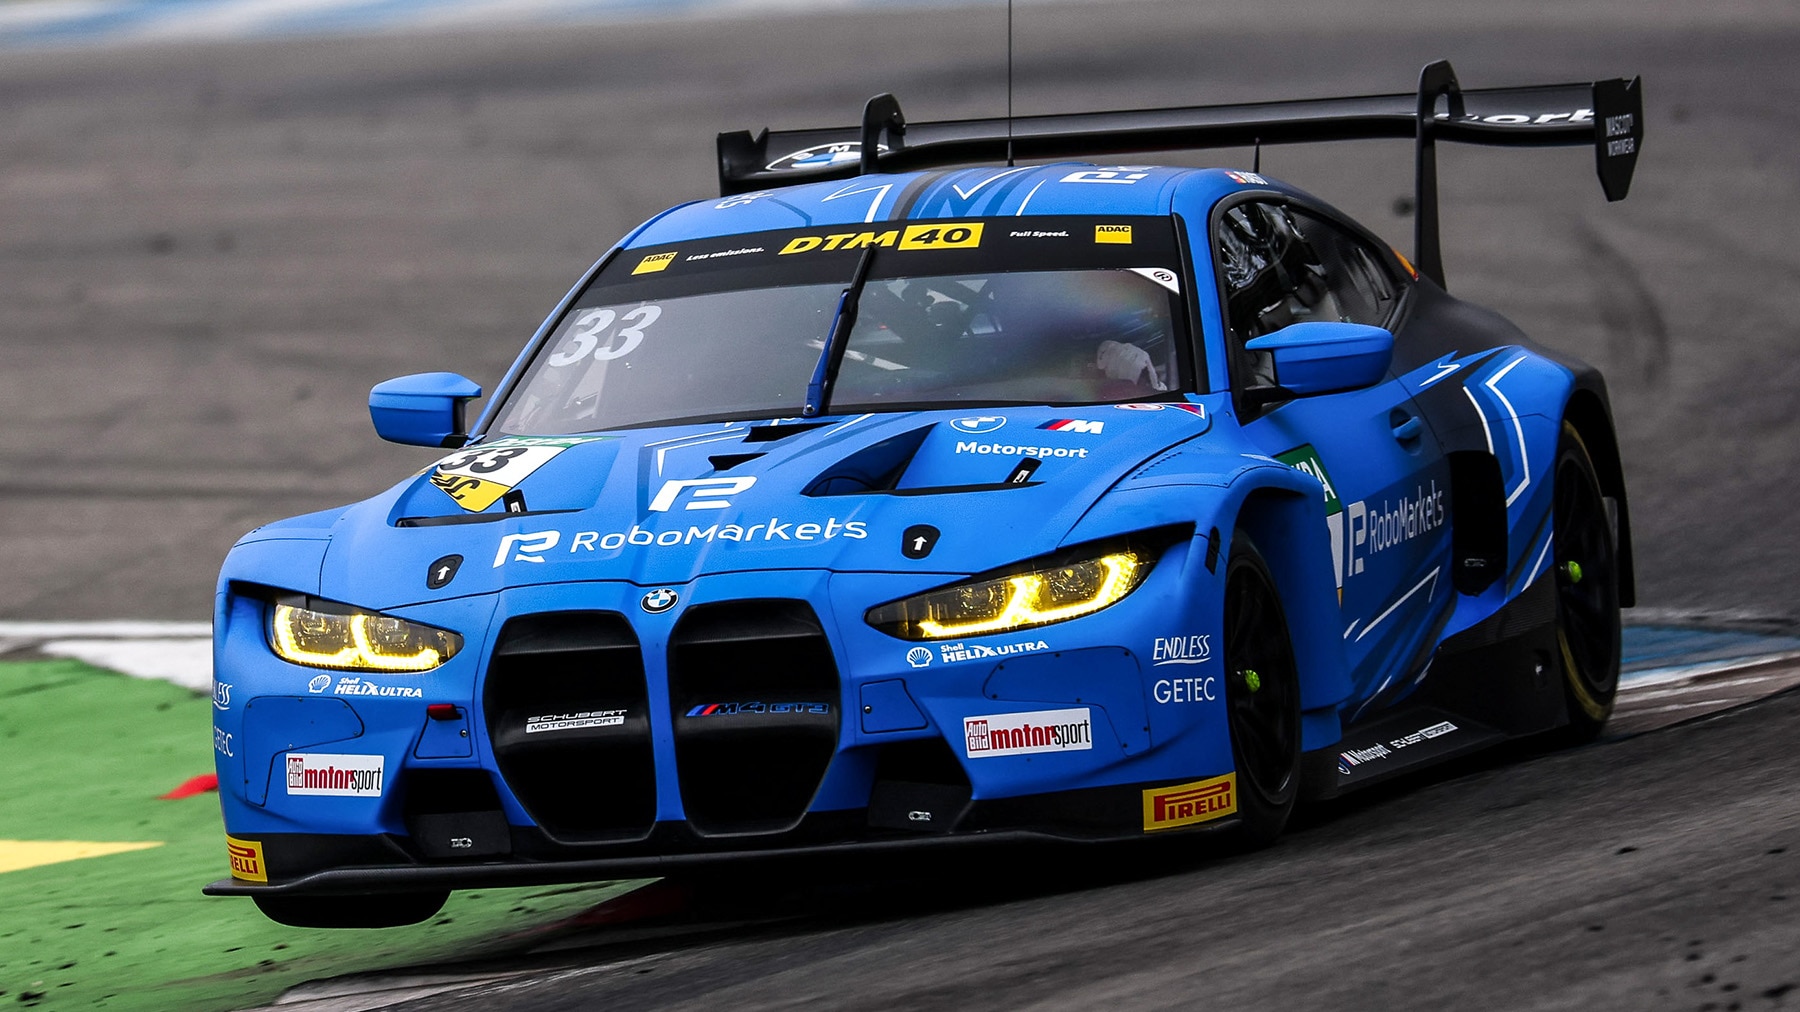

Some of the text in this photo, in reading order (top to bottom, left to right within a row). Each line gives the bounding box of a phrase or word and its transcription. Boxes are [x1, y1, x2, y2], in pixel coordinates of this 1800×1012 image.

[778, 228, 972, 255] DTM 40
[643, 253, 674, 263] ADAC
[549, 305, 662, 367] 33
[439, 447, 528, 473] 33
[955, 441, 1088, 459] Motorsport
[1369, 479, 1444, 555] RoboMarkets
[569, 516, 868, 554] RoboMarkets
[940, 643, 964, 653] Shell
[996, 640, 1049, 655] ULTRA
[1153, 634, 1211, 660] ENDLESS
[338, 677, 360, 685] Shell
[379, 686, 423, 698] ULTRA
[1153, 676, 1216, 704] GETEC
[527, 709, 628, 723] SCHUBERT
[530, 717, 620, 731] MOTORSPORT
[1153, 780, 1231, 822] PIRELLI
